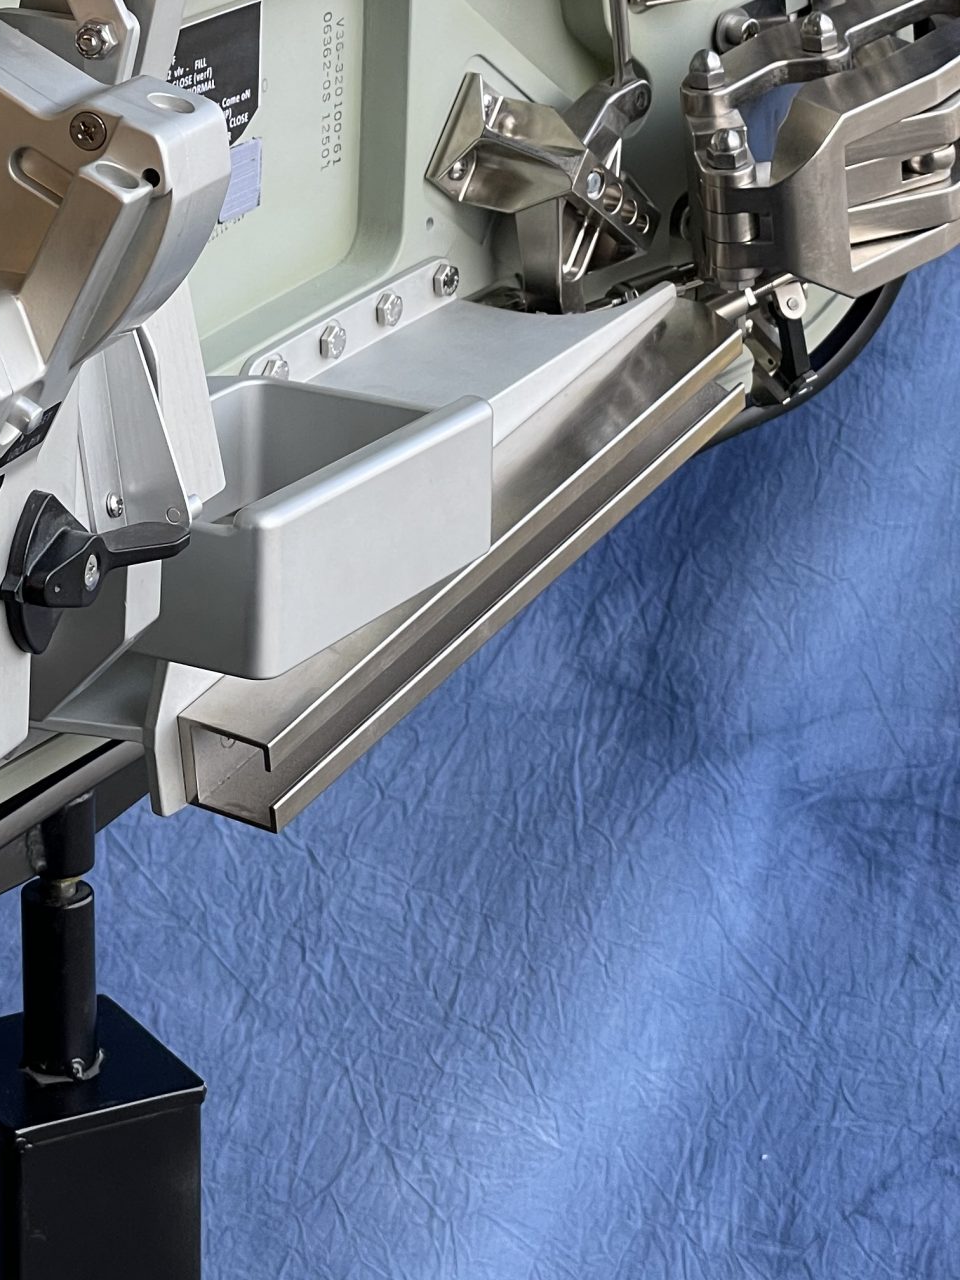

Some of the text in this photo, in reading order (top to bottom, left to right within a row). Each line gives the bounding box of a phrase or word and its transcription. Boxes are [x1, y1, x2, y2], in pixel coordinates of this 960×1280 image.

[194, 57, 207, 70] FILL
[187, 79, 216, 94] ORMAL
[229, 111, 249, 128] CLOSE
